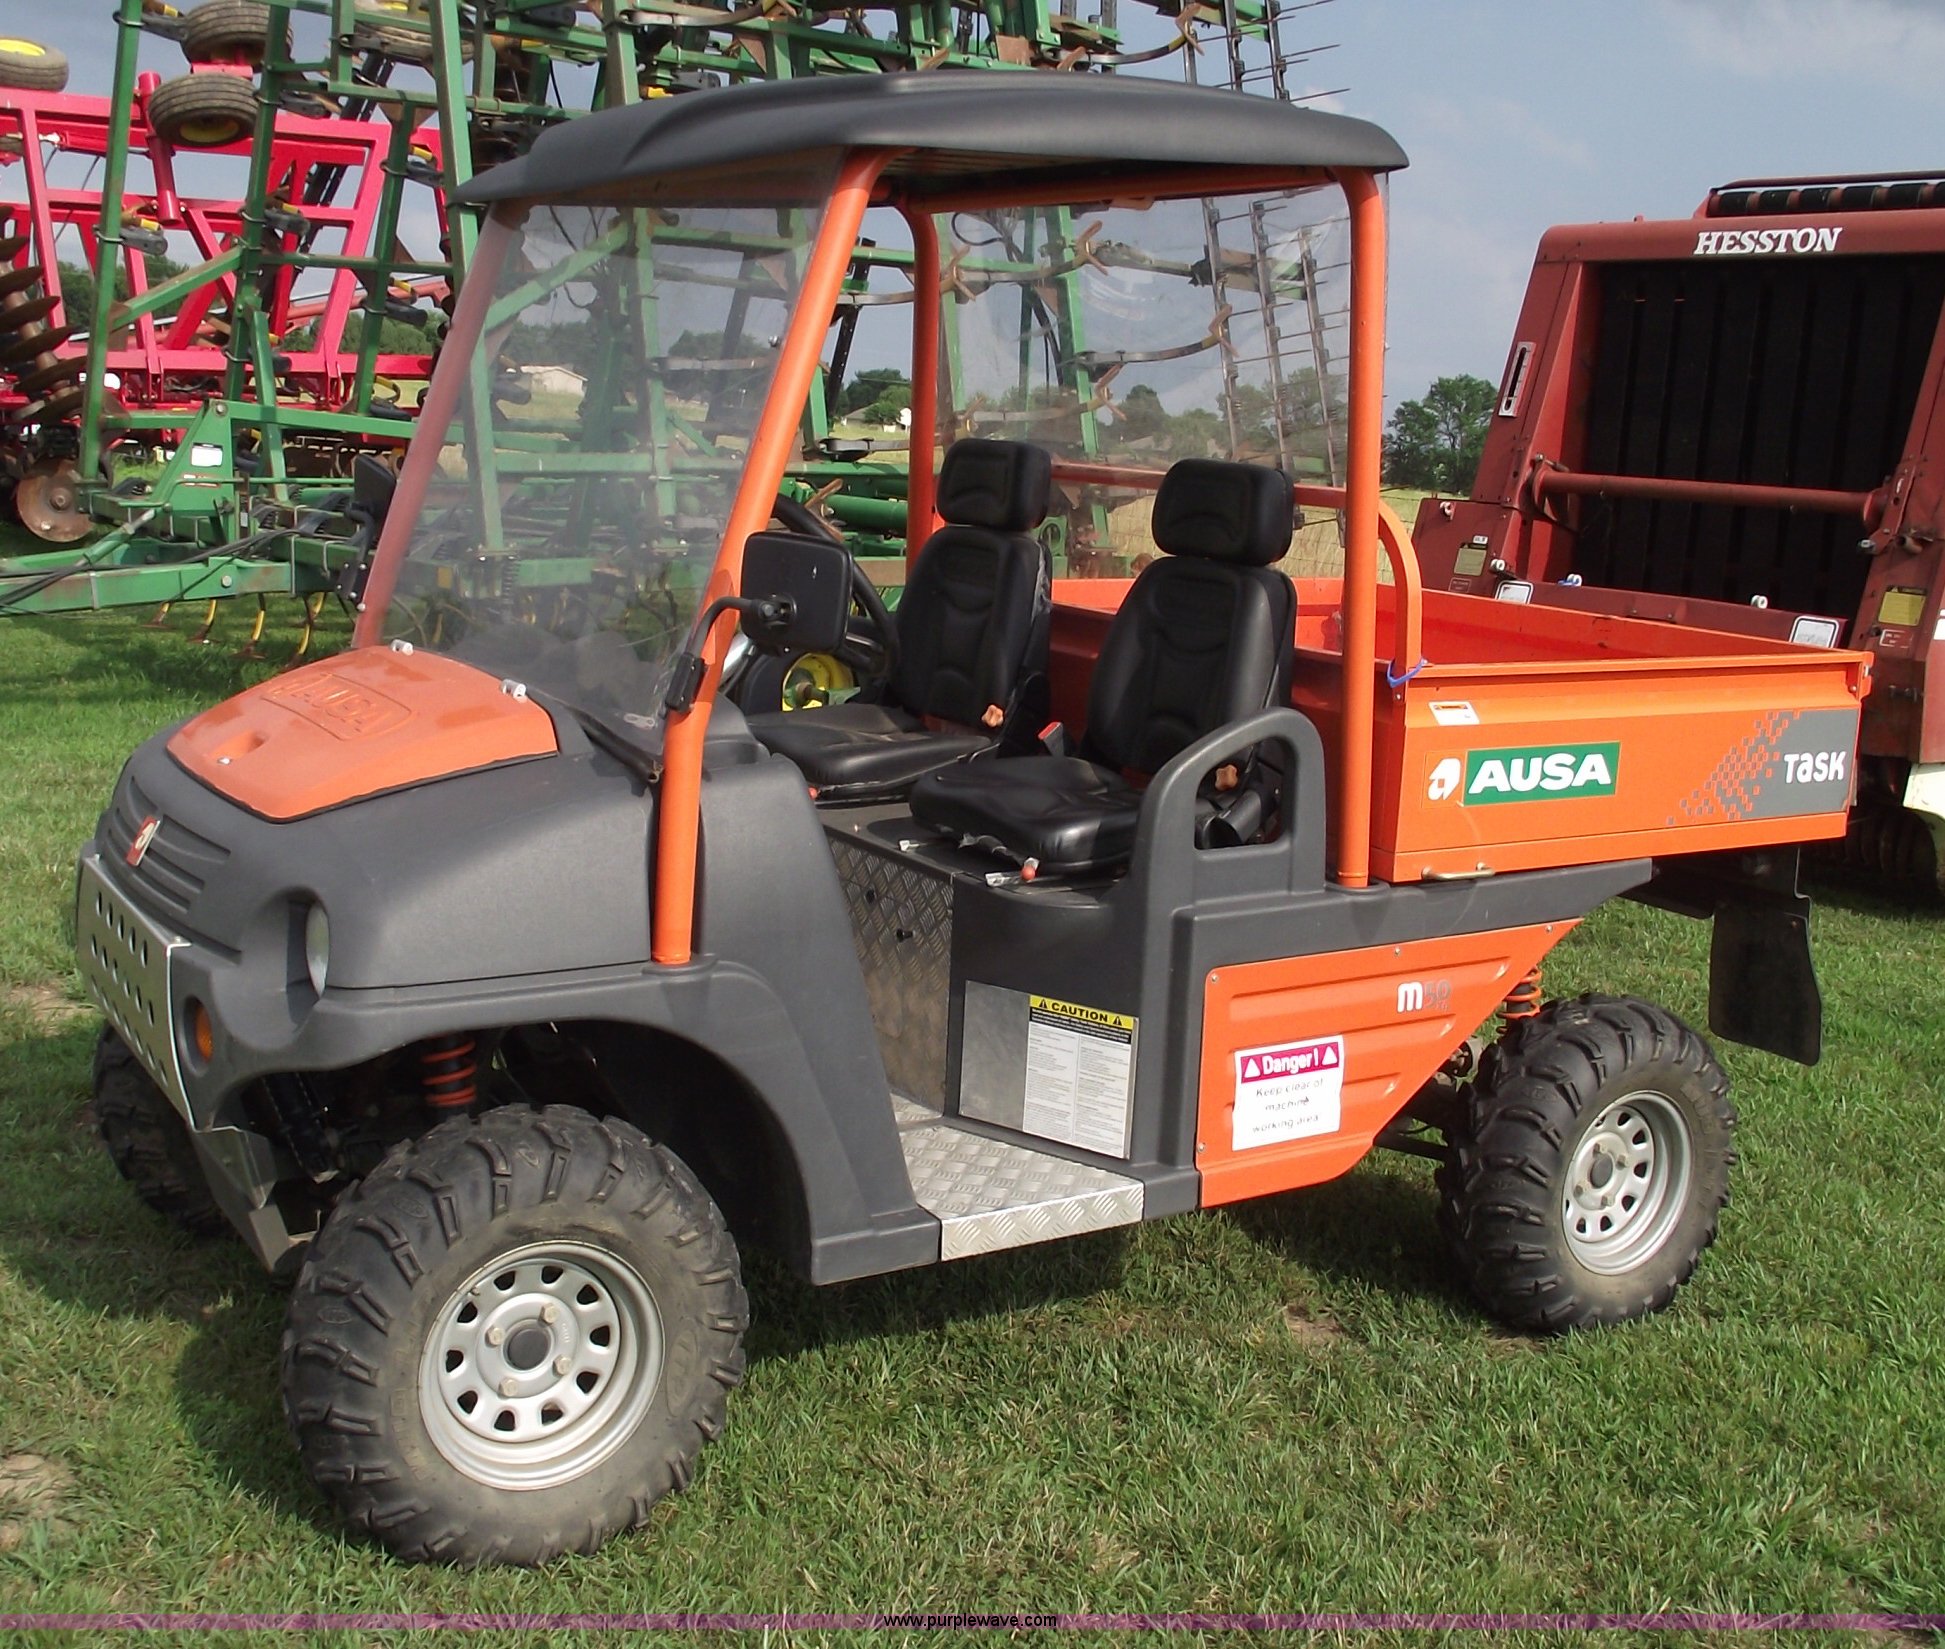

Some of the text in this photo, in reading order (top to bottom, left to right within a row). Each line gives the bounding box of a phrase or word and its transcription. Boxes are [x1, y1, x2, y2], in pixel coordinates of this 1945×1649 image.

[1693, 227, 1843, 255] HESSTON
[1468, 753, 1612, 794] AUSA
[1051, 1002, 1108, 1023] CAUTION
[1256, 1087, 1282, 1097] Keep
